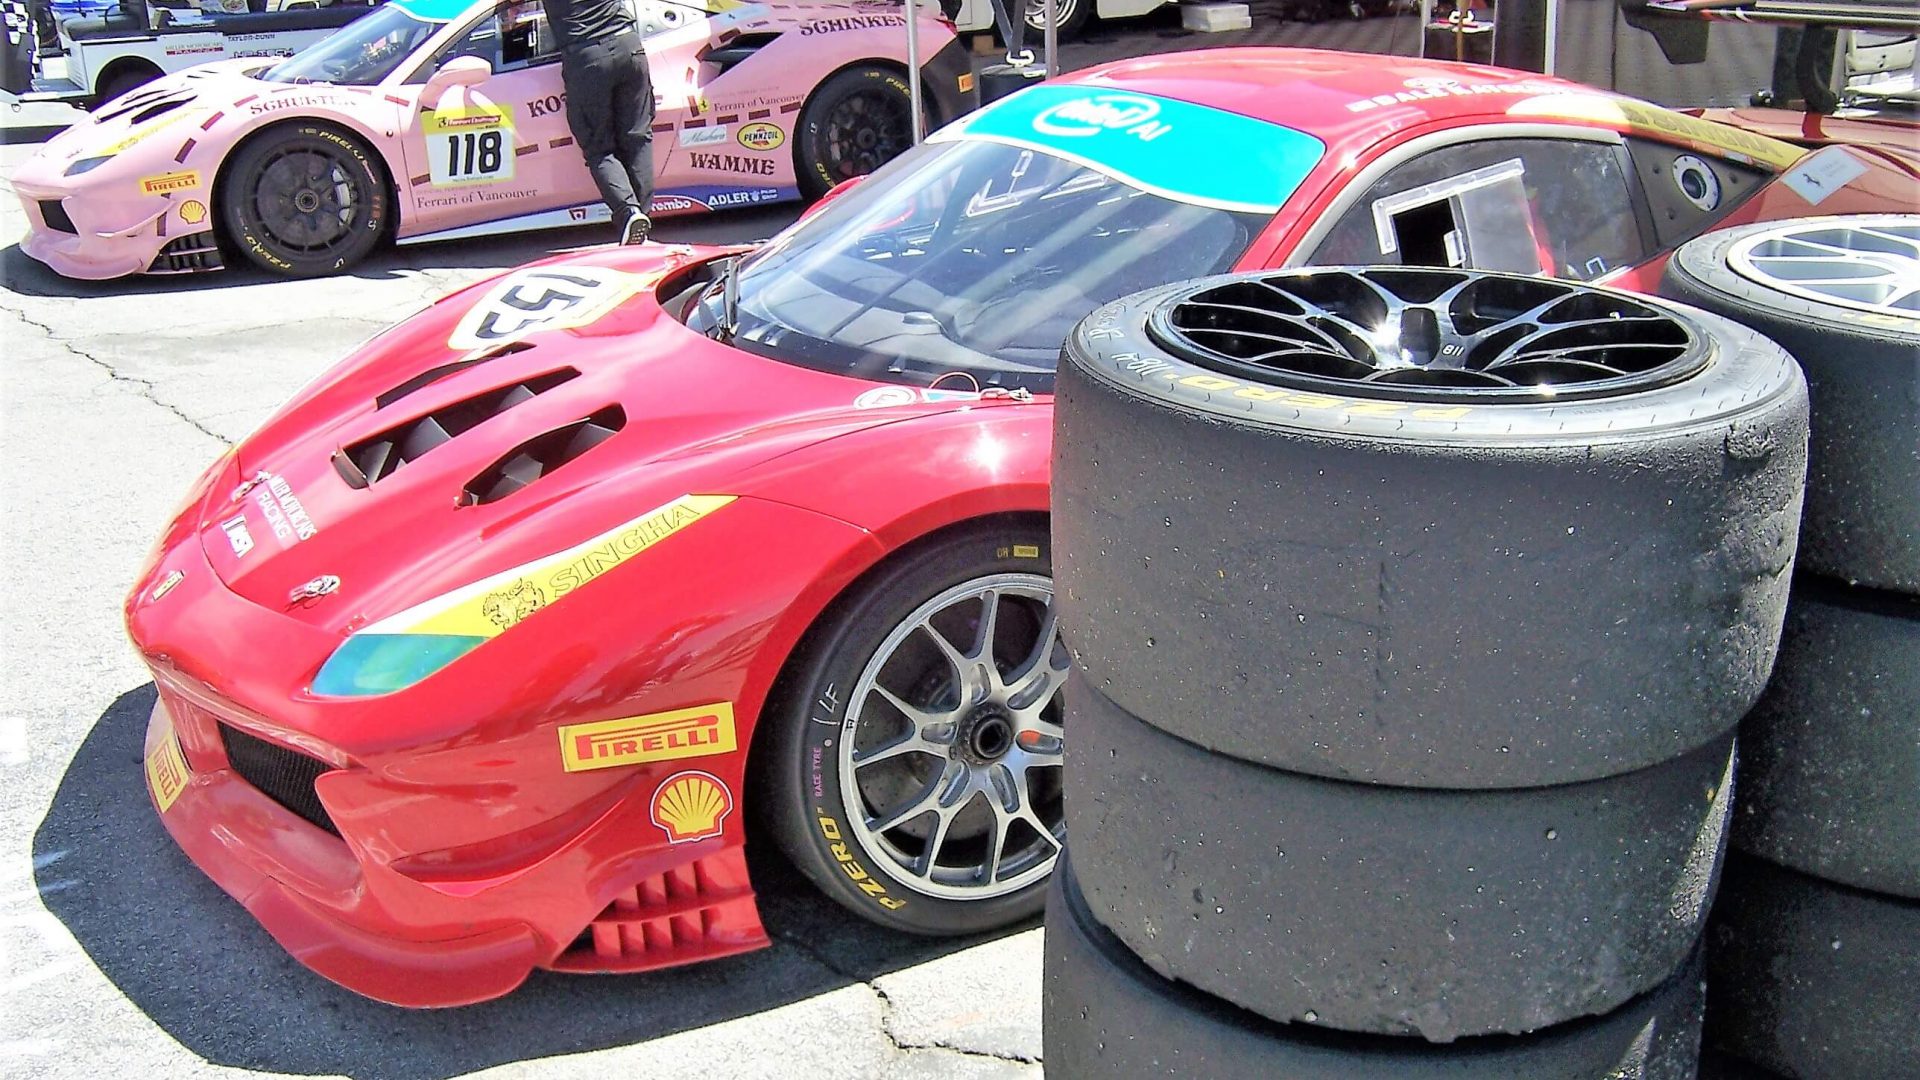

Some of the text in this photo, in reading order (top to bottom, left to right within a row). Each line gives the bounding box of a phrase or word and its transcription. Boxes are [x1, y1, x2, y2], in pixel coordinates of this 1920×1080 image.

[713, 94, 806, 112] Ferrari of Vancouver
[744, 131, 779, 142] PENNZOIL
[448, 130, 502, 177] 118
[689, 152, 775, 176] WAMME
[144, 174, 196, 192] PIRELLI
[417, 196, 458, 209] Ferrari
[461, 192, 474, 204] of
[477, 188, 538, 202] Vancouver
[652, 198, 692, 212] rembo
[707, 192, 750, 207] ADLER
[549, 504, 700, 598] SINGHA
[575, 714, 719, 761] PIRELLI
[153, 741, 182, 800] PIRELLI
[813, 747, 823, 797] RACE TYRE
